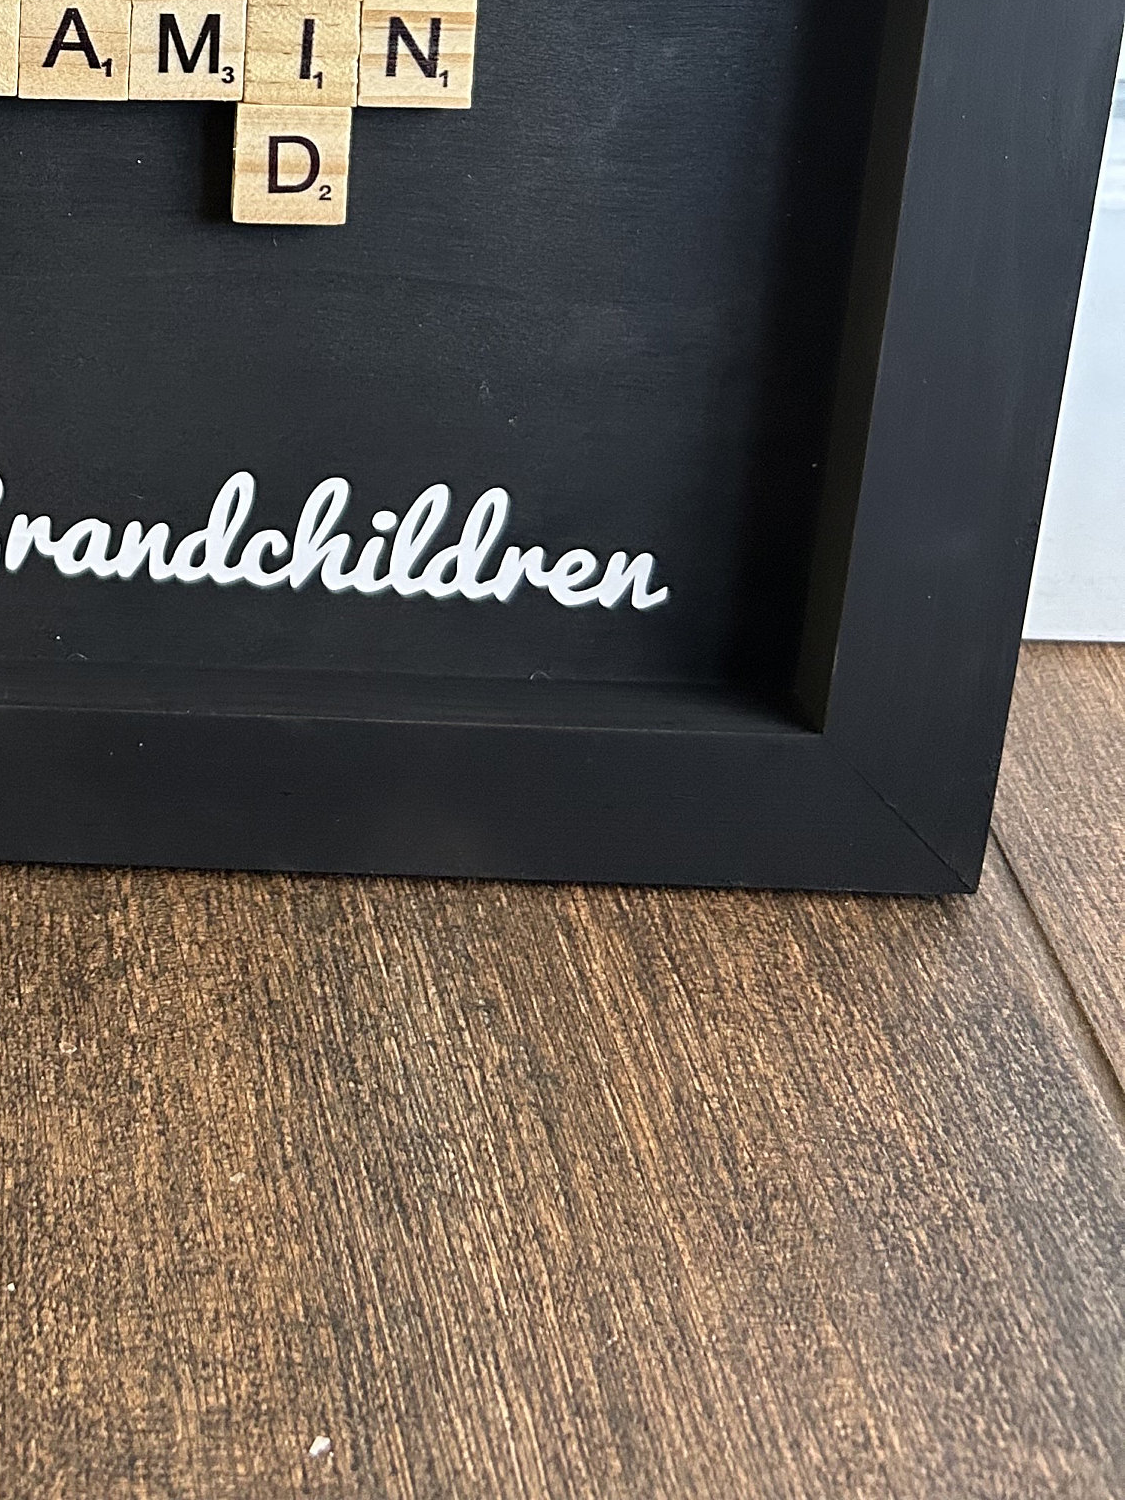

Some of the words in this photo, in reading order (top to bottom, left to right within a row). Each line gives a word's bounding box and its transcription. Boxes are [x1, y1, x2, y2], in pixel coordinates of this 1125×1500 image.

[101, 57, 114, 78] 1
[221, 66, 236, 84] 3
[312, 71, 324, 90] 1
[438, 69, 450, 88] 1
[318, 184, 333, 201] 2
